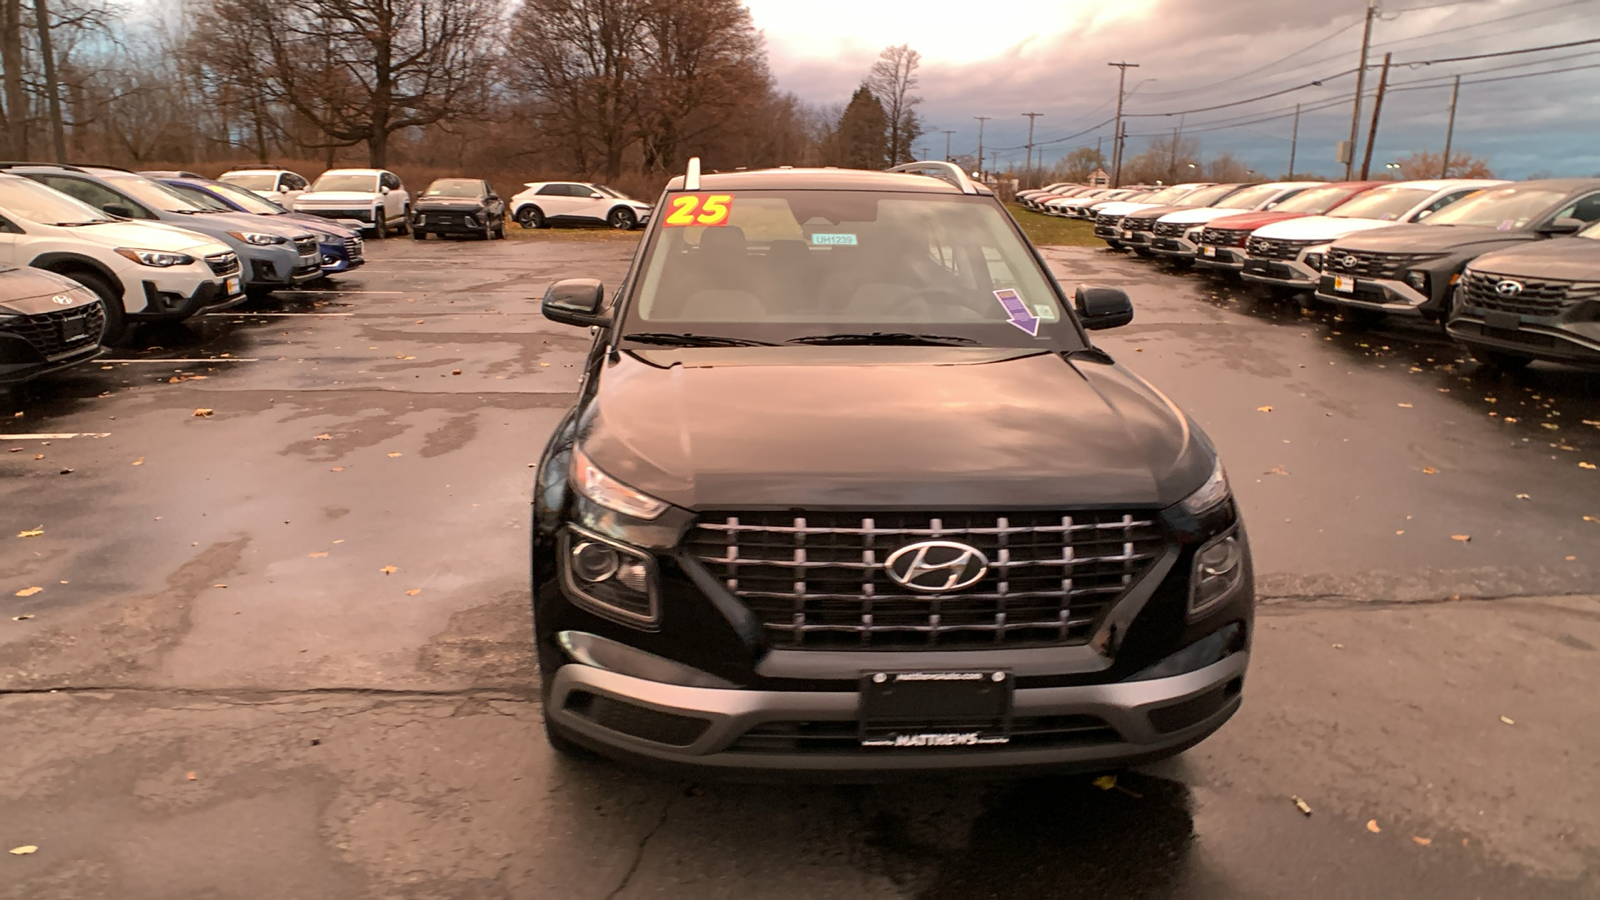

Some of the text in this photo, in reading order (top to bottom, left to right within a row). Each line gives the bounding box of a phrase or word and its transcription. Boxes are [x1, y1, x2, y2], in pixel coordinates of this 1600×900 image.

[666, 195, 731, 225] 25
[815, 235, 853, 244] UH1239
[894, 732, 978, 747] MATTHEWS
